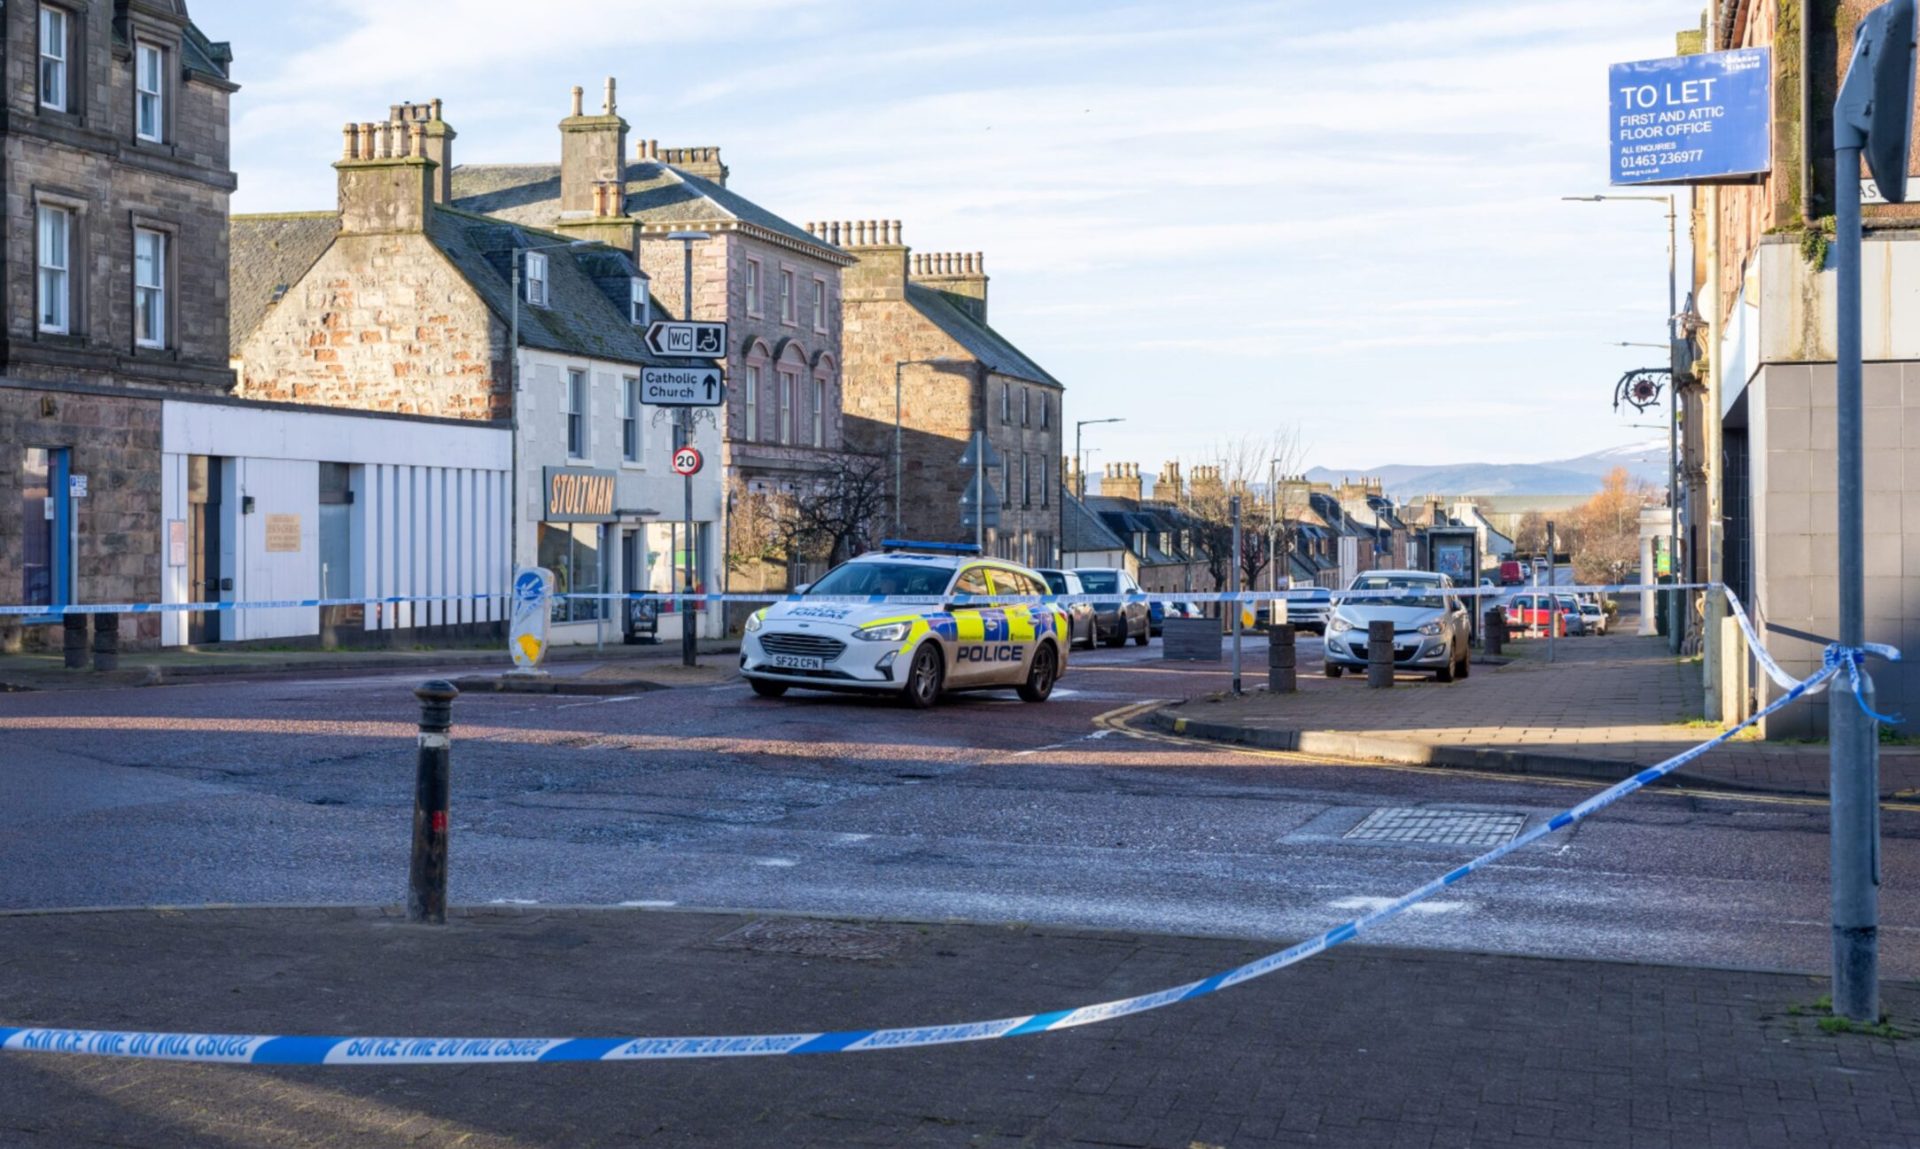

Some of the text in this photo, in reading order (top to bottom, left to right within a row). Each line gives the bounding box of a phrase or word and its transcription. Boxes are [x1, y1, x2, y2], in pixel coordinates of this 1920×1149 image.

[1620, 78, 1717, 109] TO LET
[1620, 105, 1724, 127] FIRST AND ATTIC
[1620, 121, 1712, 140] FLOOR OFFICE
[1621, 142, 1677, 154] ALL ENQUIRIES
[1621, 149, 1704, 168] 01463 236977
[671, 332, 690, 346] WC
[646, 372, 698, 384] Catholic
[649, 386, 694, 398] Church
[677, 455, 695, 467] 20
[551, 474, 614, 514] STOLTMAN
[956, 645, 1023, 662] POLICE
[775, 655, 818, 668] SF22 CFN
